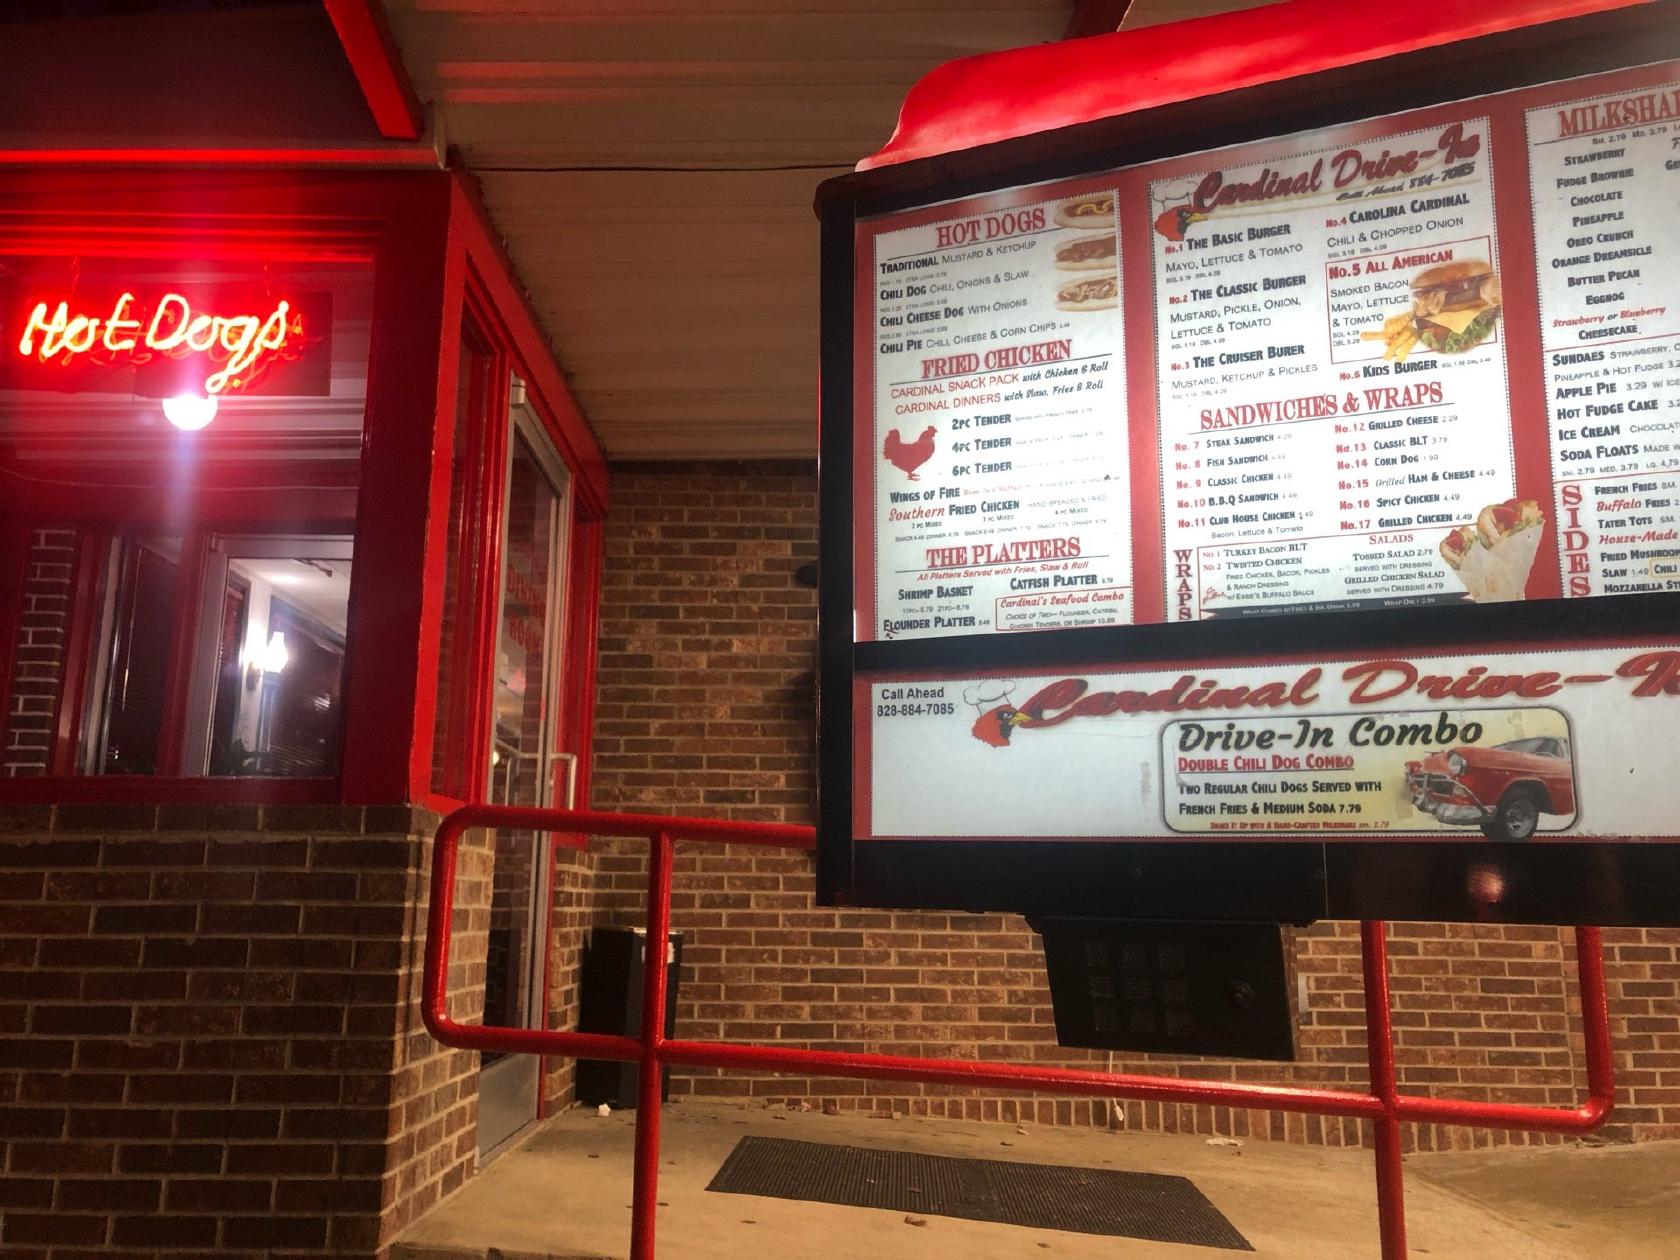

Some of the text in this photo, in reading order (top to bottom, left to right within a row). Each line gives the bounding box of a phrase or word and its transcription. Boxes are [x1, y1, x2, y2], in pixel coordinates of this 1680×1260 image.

[1564, 149, 1626, 166] STRAWBERRY
[1193, 158, 1323, 208] Cardinal
[1557, 169, 1633, 189] FUDGE BROWNIE
[1571, 191, 1623, 207] CHOCOLATE
[1350, 205, 1405, 224] CAROLINA
[1411, 193, 1469, 213] CARDINAL
[936, 208, 1046, 247] HOT DOGS
[1573, 211, 1624, 227] PINEAPPLE
[1187, 238, 1208, 250] THE
[1212, 233, 1243, 247] BASIC
[1248, 224, 1290, 240] BURGER
[1567, 230, 1633, 248] OREO CRUNCH
[880, 241, 1036, 275] TRADITIONAL MUSTARD & KETCHUP
[1201, 253, 1244, 267] LETTUCE
[1248, 250, 1256, 260] &
[1260, 244, 1303, 257] TOMATO
[1366, 260, 1388, 273] ALL
[1392, 250, 1453, 269] AMERICAN
[1552, 246, 1652, 269] ORANGE DREAMSICLE
[880, 287, 903, 300] CHILI
[906, 285, 926, 297] DOG
[956, 276, 991, 289] ONIONS
[993, 274, 1000, 283] &
[1003, 270, 1029, 281] SLAW
[1568, 269, 1640, 287] BUTTER PECAN
[1191, 289, 1212, 301] THE
[1216, 282, 1258, 298] CLASSIC
[1263, 275, 1306, 290] BURGER
[1331, 279, 1409, 298] SMOKED BACON
[1586, 292, 1624, 306] EGGNOG
[1553, 314, 1604, 328] Strawberry
[1620, 306, 1666, 319] Blueberry
[20, 293, 289, 394] Hot Dogs
[921, 339, 1072, 379] FRIED CHICKEN
[1553, 351, 1604, 366] SUNDAES
[891, 385, 945, 399] CARDINAL
[948, 377, 986, 392] SNACK
[990, 373, 1018, 387] PACK
[1022, 373, 1041, 382] with
[1556, 386, 1592, 399] APPLE
[1597, 383, 1616, 394] PIE
[1201, 382, 1443, 430] SANDWICHES & WRAPS
[1558, 400, 1658, 420] HOT FUDGE CAKE
[952, 417, 970, 430] 2PC
[975, 414, 1011, 427] TENDER
[1559, 425, 1620, 440] ICE CREAM
[1560, 444, 1669, 461] SODA FLOATS MADE
[890, 488, 960, 504] WINGS OF FIRE
[1595, 483, 1657, 495] FRENCH FRIES
[889, 501, 1019, 522] Southern FRIED CHICKEN
[1597, 499, 1670, 512] Buffalo FRIES
[1378, 518, 1412, 528] GRILLED
[1417, 514, 1452, 524] CHICKEN
[1598, 516, 1652, 528] TATER TOTS
[1369, 534, 1414, 544] SALADS
[1562, 485, 1591, 597] SIDES
[1599, 529, 1678, 545] House-Made
[927, 537, 1081, 568] THE PLATTERS
[1223, 543, 1307, 557] TURKEY BACON BLT
[1353, 553, 1384, 561] TOSSED
[1388, 550, 1415, 558] SALAD
[1601, 552, 1627, 562] FRIED
[1226, 558, 1302, 569] TWISTED CHICKEN
[1010, 575, 1097, 590] CATFISH PLATTER
[1173, 550, 1193, 620] WRAPS
[1381, 573, 1416, 582] CHICKEN
[898, 586, 973, 600] SHRIMP BASKET
[1604, 582, 1662, 593] MOZZARELLA
[1051, 594, 1089, 605] Seafood
[1091, 592, 1124, 602] Combo
[883, 616, 975, 632] FLOUNDER PLATTER
[881, 687, 944, 700] Call Ahead
[1020, 667, 1322, 728] Cardinal
[877, 703, 954, 716] 828-884-7085
[1179, 712, 1482, 752] Drive-In Combo
[1179, 754, 1354, 771] DOUBLE CHILI DOG COMBO
[1179, 781, 1381, 794] TWO REGULAR CHILI DOGS SERVED WITH
[1179, 803, 1215, 814] FRENCH
[1220, 803, 1247, 814] FRIES
[1251, 803, 1259, 814] &
[1264, 802, 1304, 814] MEDIUM
[1308, 802, 1335, 813] SODA
